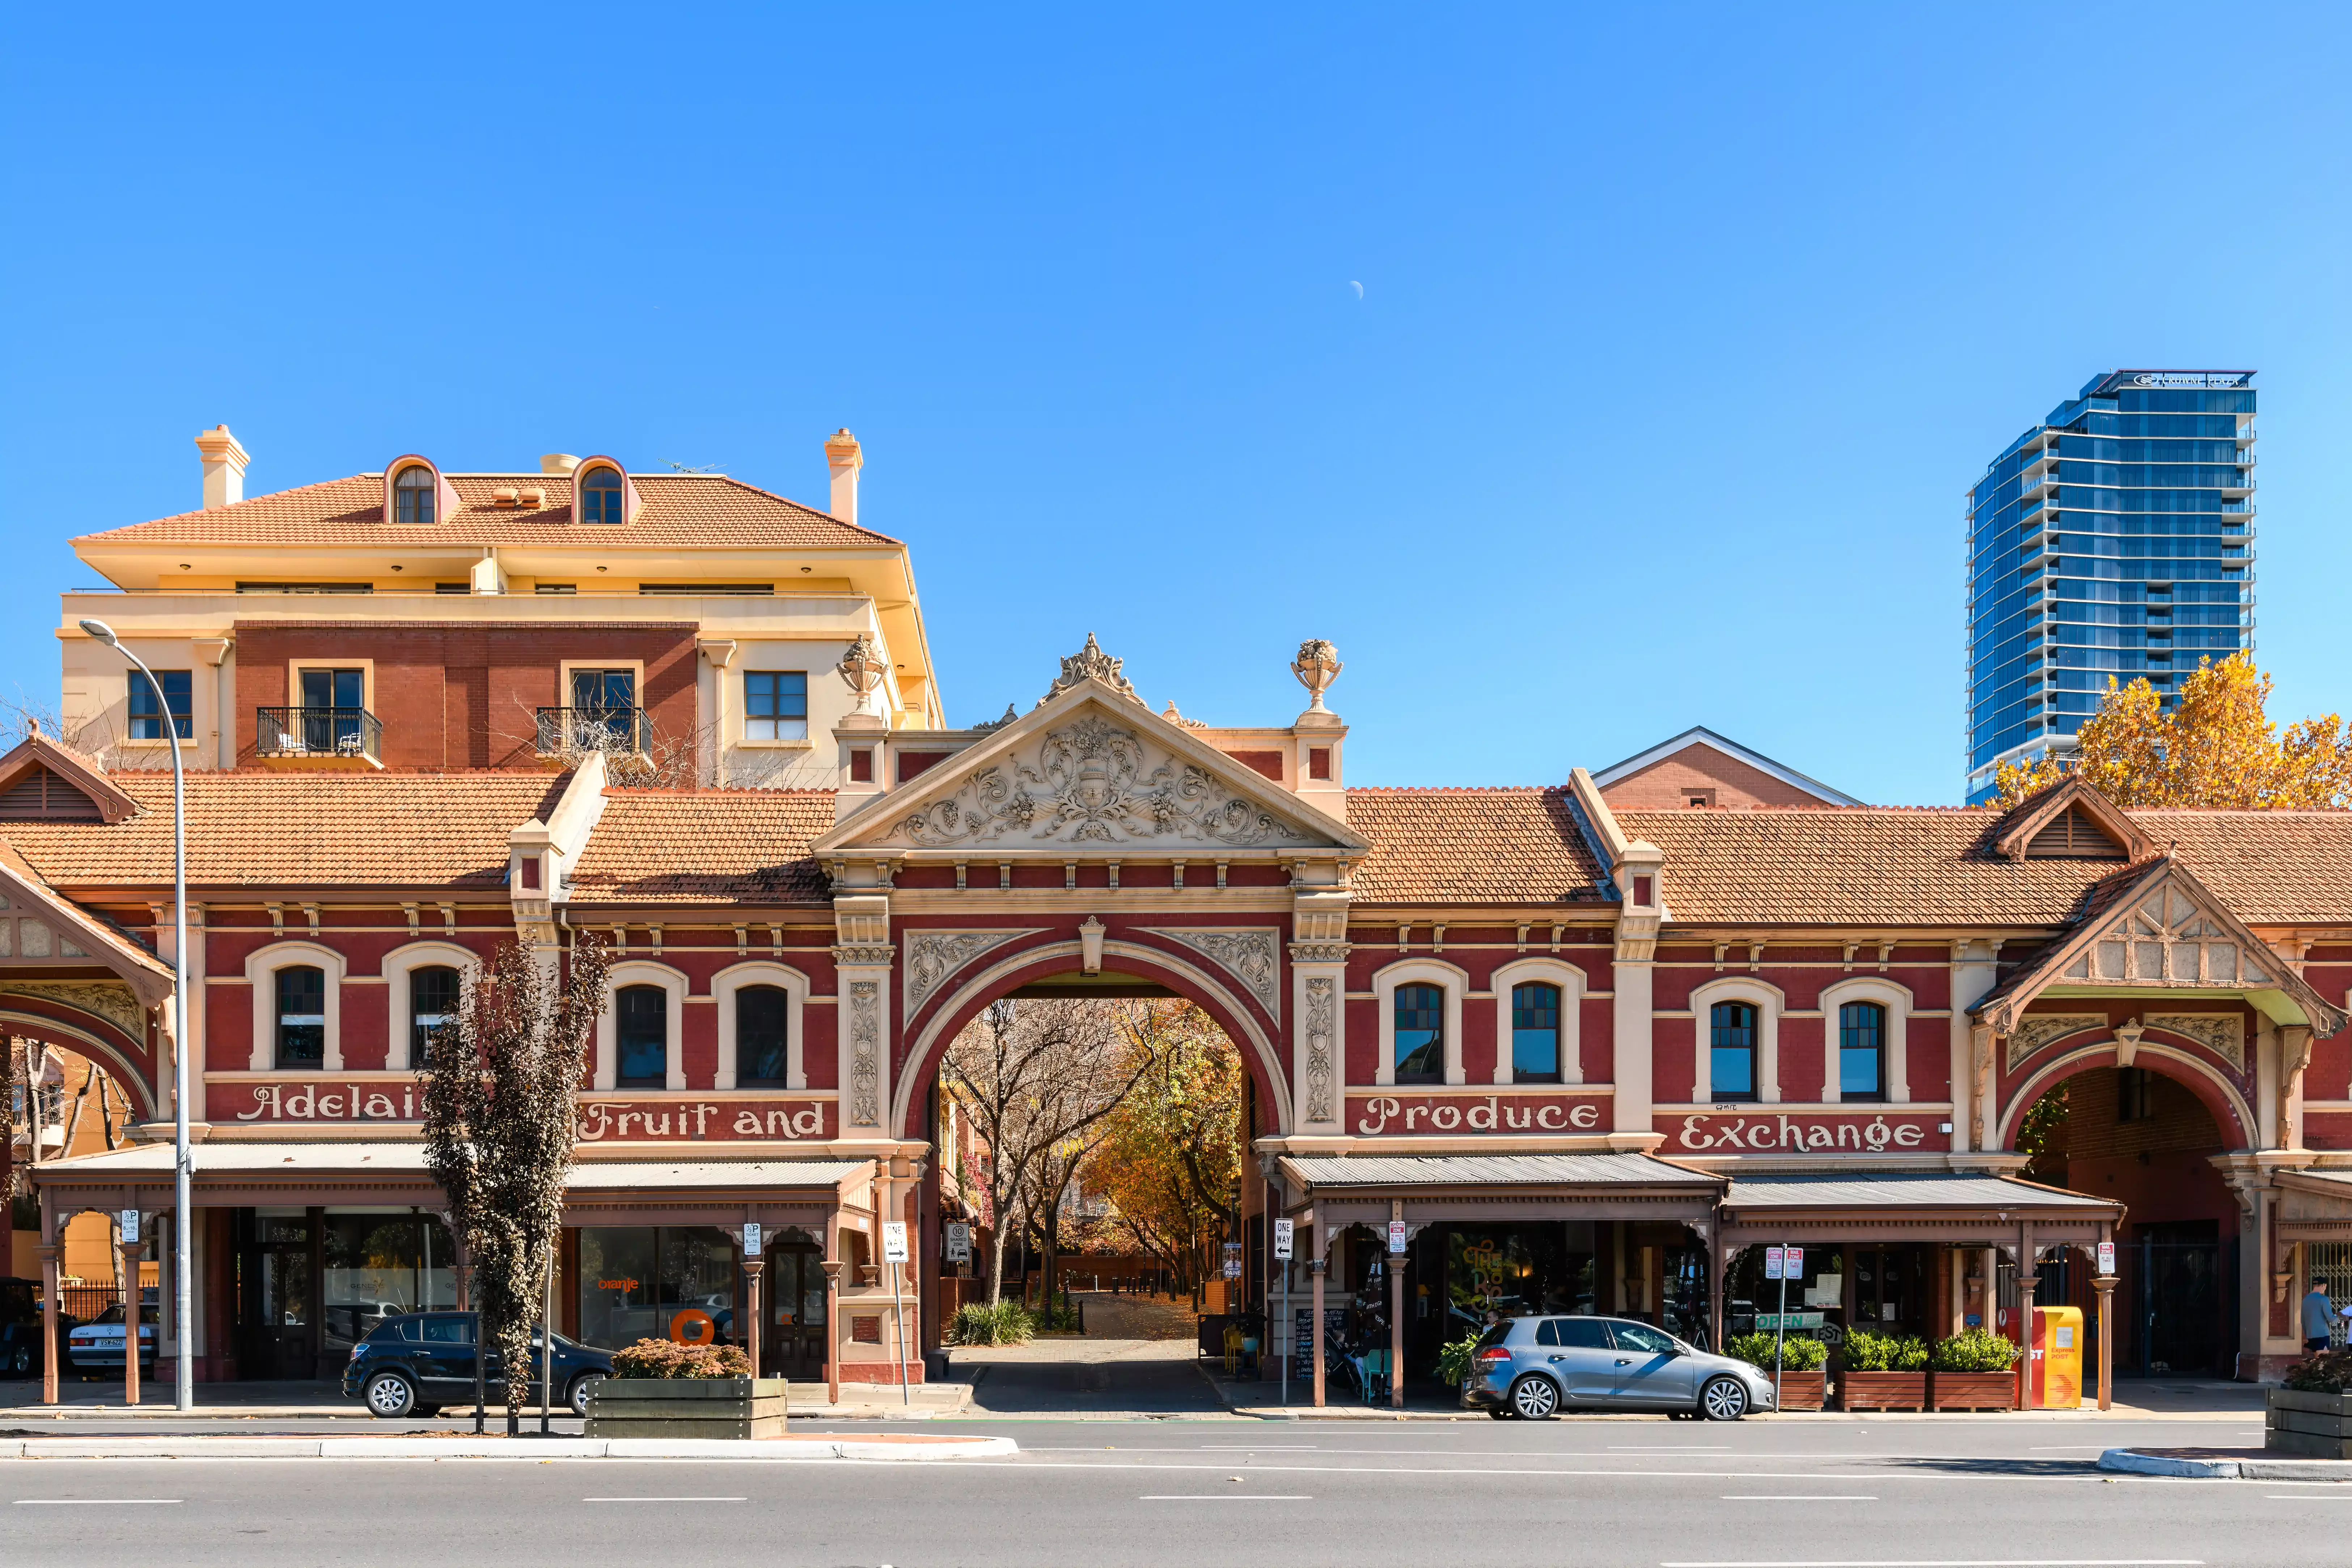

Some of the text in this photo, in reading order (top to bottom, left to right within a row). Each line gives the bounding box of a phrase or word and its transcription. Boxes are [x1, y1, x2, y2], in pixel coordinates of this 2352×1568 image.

[2208, 376, 2238, 385] PLAZA
[237, 1084, 413, 1120] Adelai
[579, 1101, 824, 1140] Fruit and
[1359, 1096, 1599, 1135] Produce
[1679, 1115, 1925, 1152] Exchange
[887, 1226, 902, 1235] ONE
[1278, 1222, 1290, 1232] ONE
[1277, 1235, 1290, 1244] WAY
[598, 1277, 638, 1293] oranje
[1756, 1315, 1803, 1327] OPEN
[1818, 1325, 1841, 1341] EST
